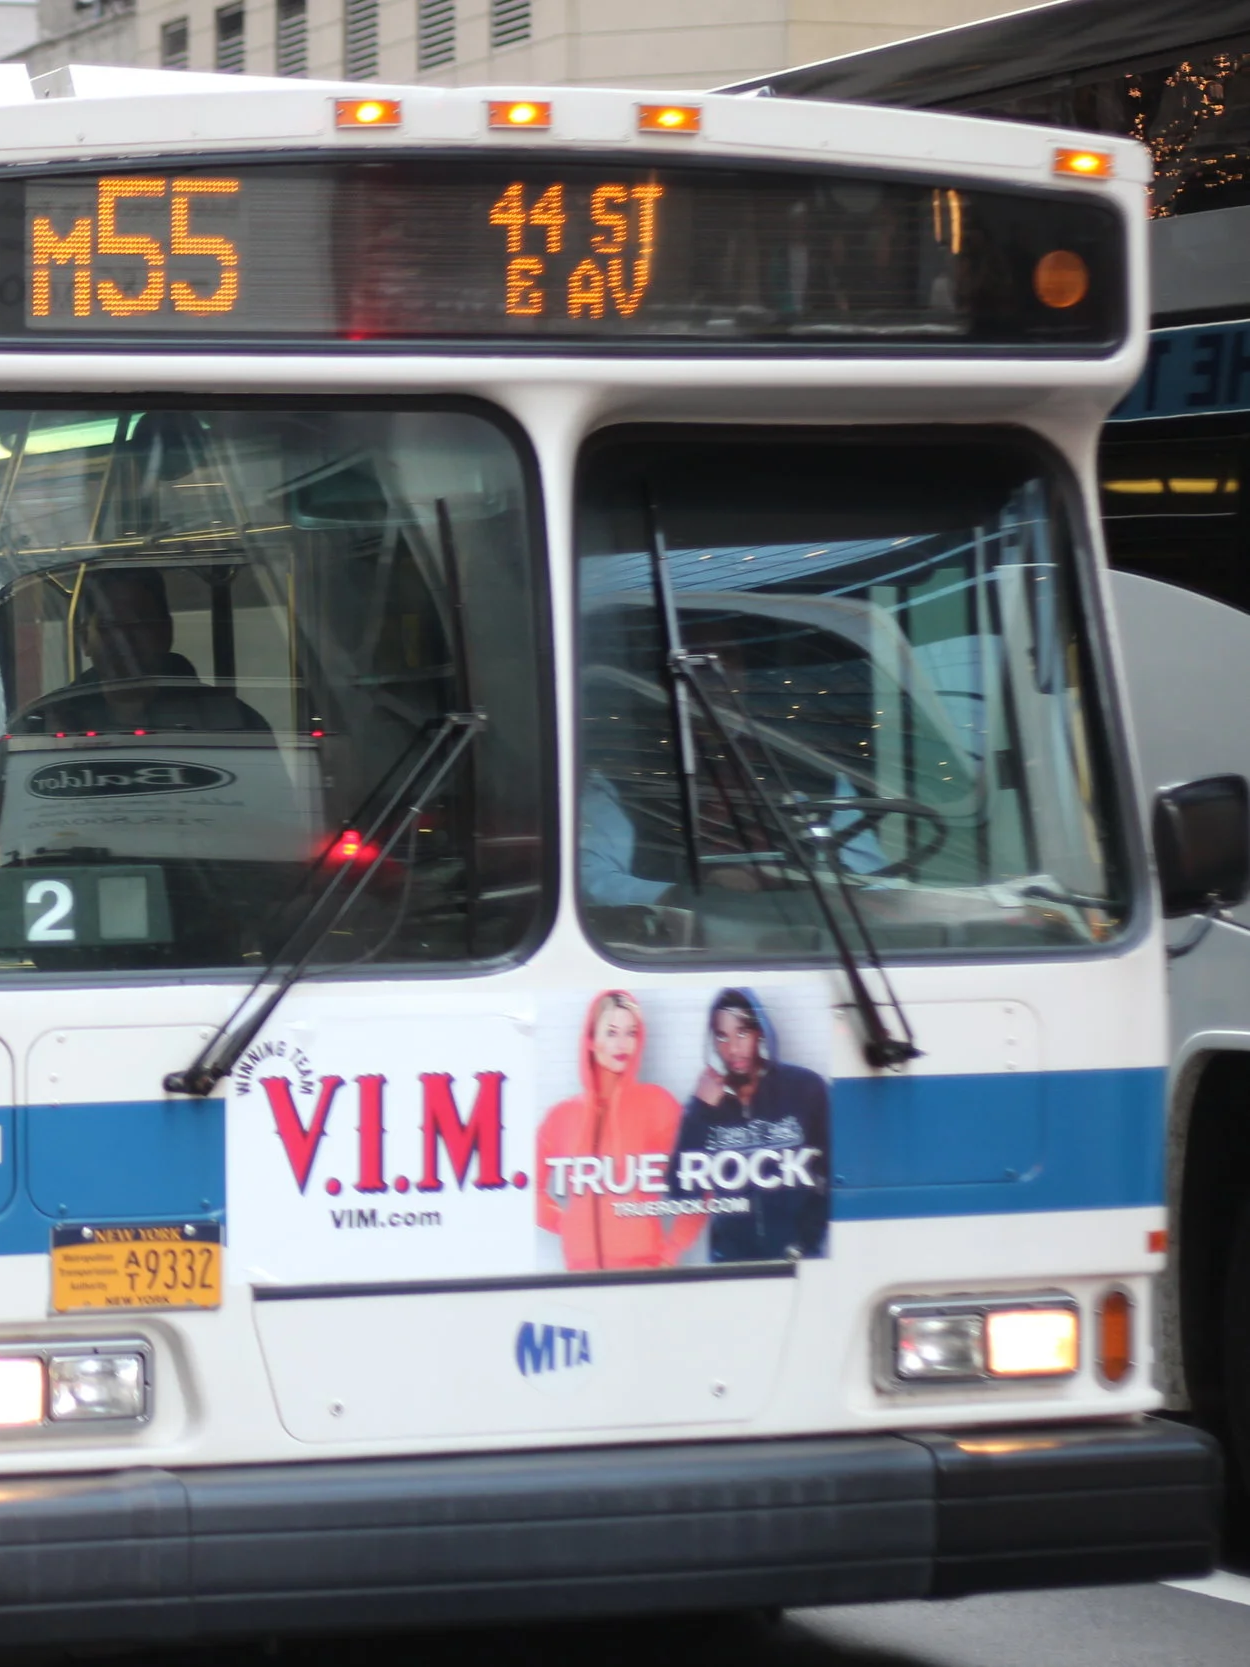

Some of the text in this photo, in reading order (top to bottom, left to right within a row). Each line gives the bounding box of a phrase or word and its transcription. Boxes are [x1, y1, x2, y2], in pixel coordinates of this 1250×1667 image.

[32, 177, 239, 317] M55
[488, 182, 664, 255] 44 ST
[567, 257, 649, 319] AV
[26, 879, 77, 942] 2
[235, 1040, 315, 1097] WINNING TEAM
[259, 1070, 529, 1197] V.I.M.
[545, 1147, 822, 1198] TRUE ROCK
[94, 1226, 183, 1242] NEW YORK
[330, 1208, 443, 1230] VIM.com
[611, 1196, 751, 1218] TRUEROCK.COM
[144, 1248, 213, 1290] 9332
[104, 1296, 133, 1306] NEW
[515, 1320, 592, 1377] MTA
